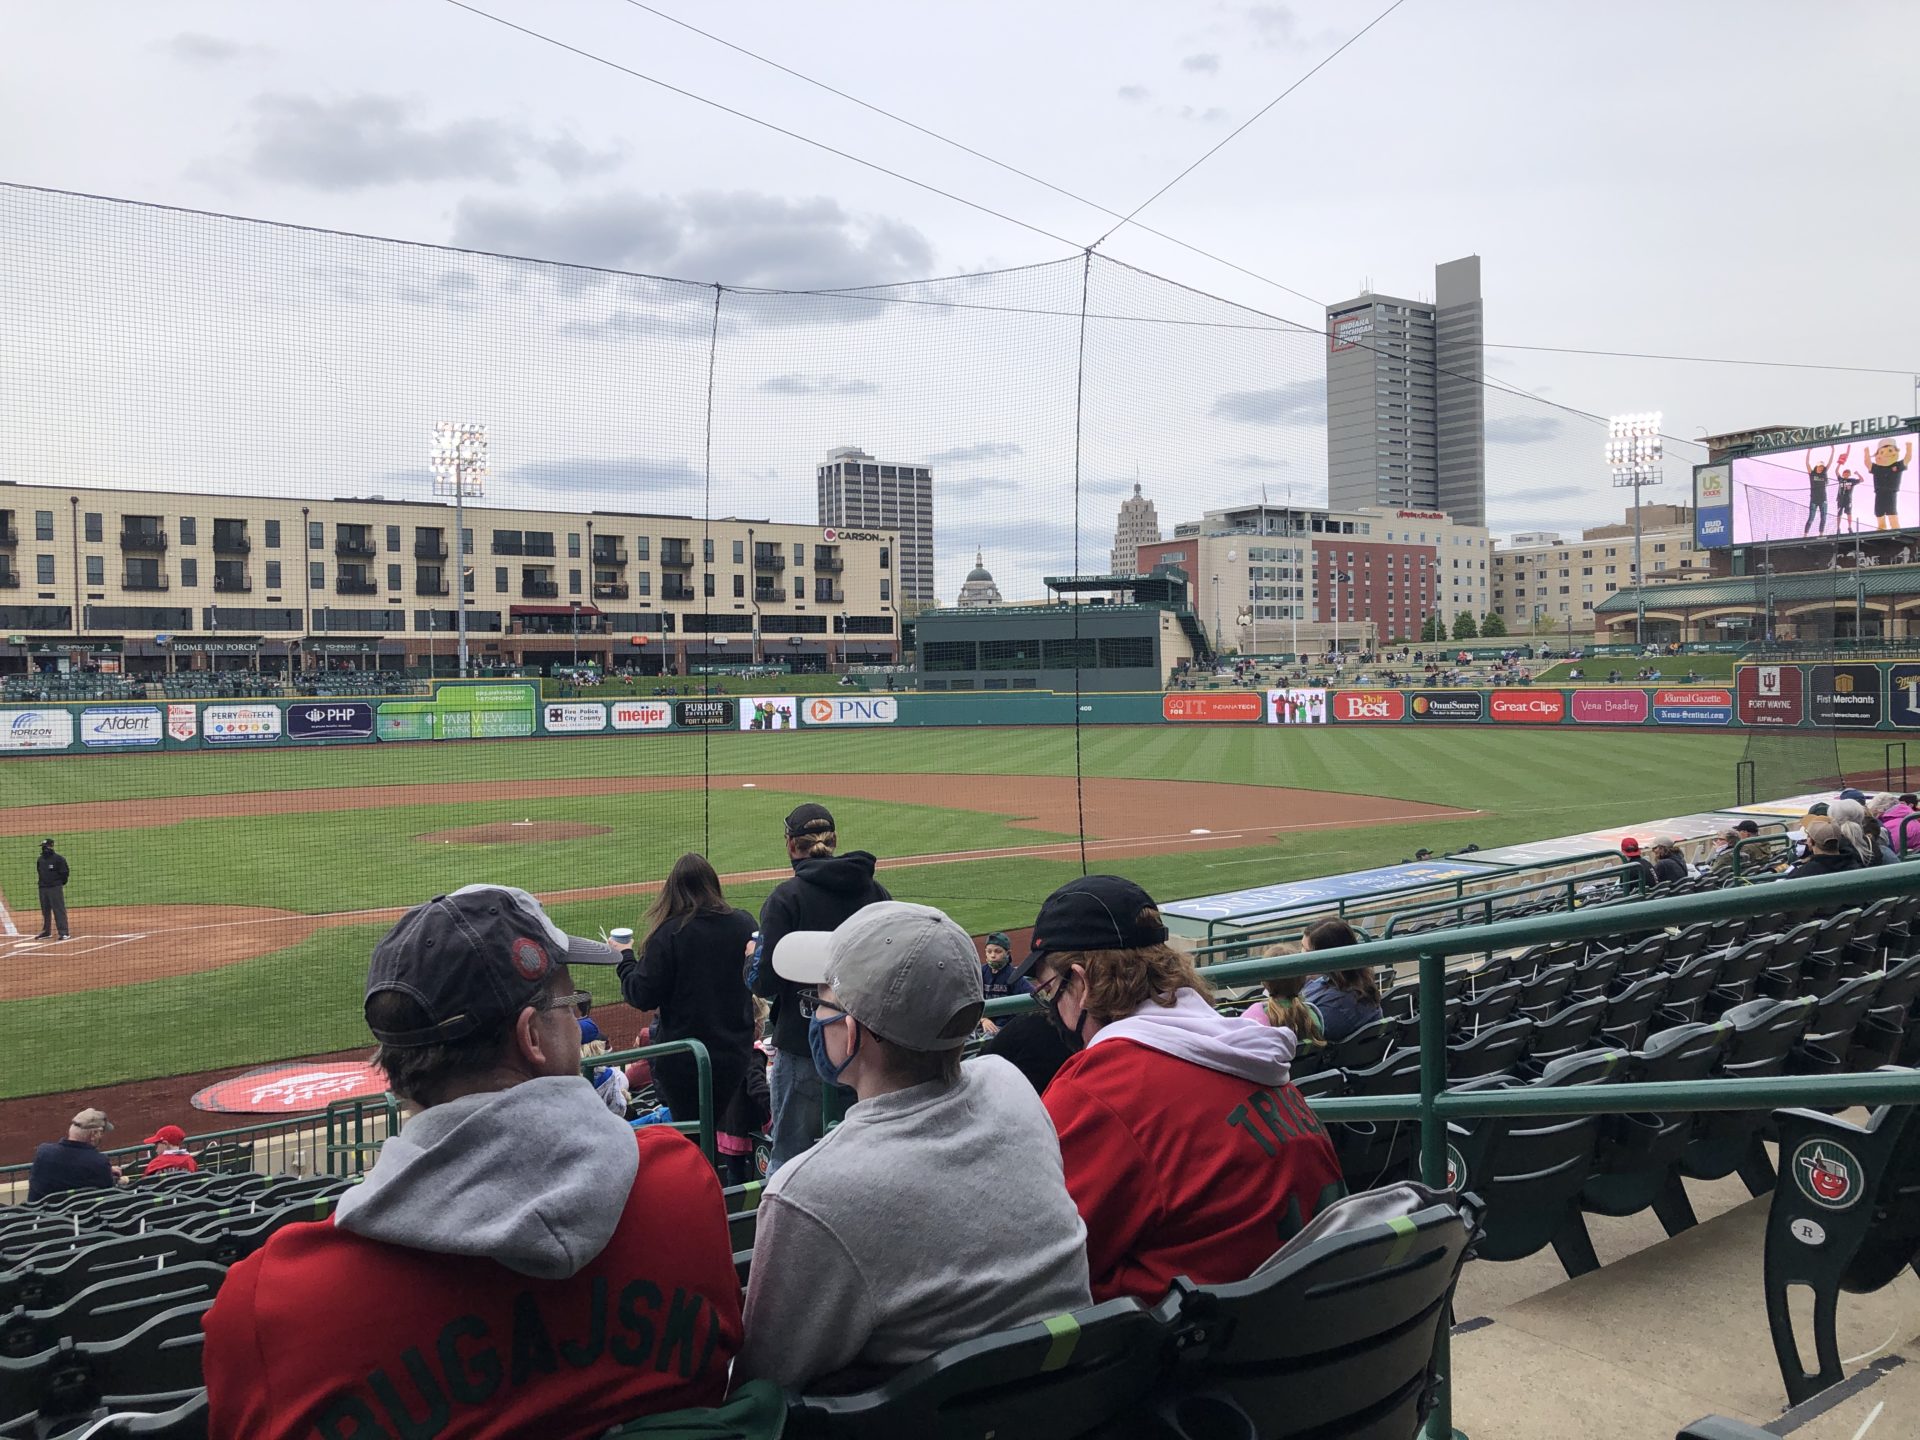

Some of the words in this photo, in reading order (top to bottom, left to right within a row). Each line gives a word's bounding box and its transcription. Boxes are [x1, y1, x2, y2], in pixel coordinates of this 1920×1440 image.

[1340, 317, 1370, 331] INDIANA
[1340, 323, 1374, 336] MICHIGAN
[1752, 422, 1844, 449] PARKVIEW
[1850, 415, 1900, 434] FIELD
[1704, 520, 1722, 528] BUD
[1701, 526, 1724, 535] LIGHT
[838, 532, 879, 542] CARSON
[174, 643, 203, 651] HOME
[205, 643, 224, 651] RUN
[226, 643, 257, 651] PORCH
[1663, 693, 1691, 703] Journal
[1691, 694, 1721, 703] Gazette
[1816, 695, 1832, 704] First
[1833, 695, 1875, 705] Merchants
[684, 702, 724, 711] PURDUE
[838, 700, 888, 719] PNC
[1168, 699, 1184, 709] GO
[1347, 697, 1390, 717] Best
[1430, 701, 1479, 710] OmniSource
[1493, 700, 1528, 712] Great
[1529, 700, 1559, 715] Clips
[1604, 699, 1639, 713] Bradley
[1748, 700, 1766, 709] FORT
[1767, 700, 1792, 709] WAYNE
[327, 708, 355, 721] PHP
[442, 712, 504, 724] PARKVIEW
[579, 714, 602, 722] County
[618, 706, 664, 724] meijer
[1661, 710, 1724, 719] News-Sentinel.com
[100, 716, 150, 730] Afdent
[11, 728, 52, 736] HORIZON
[442, 725, 497, 736] PHYSICIANS
[499, 723, 531, 733] GROUP
[1801, 1225, 1813, 1238] R
